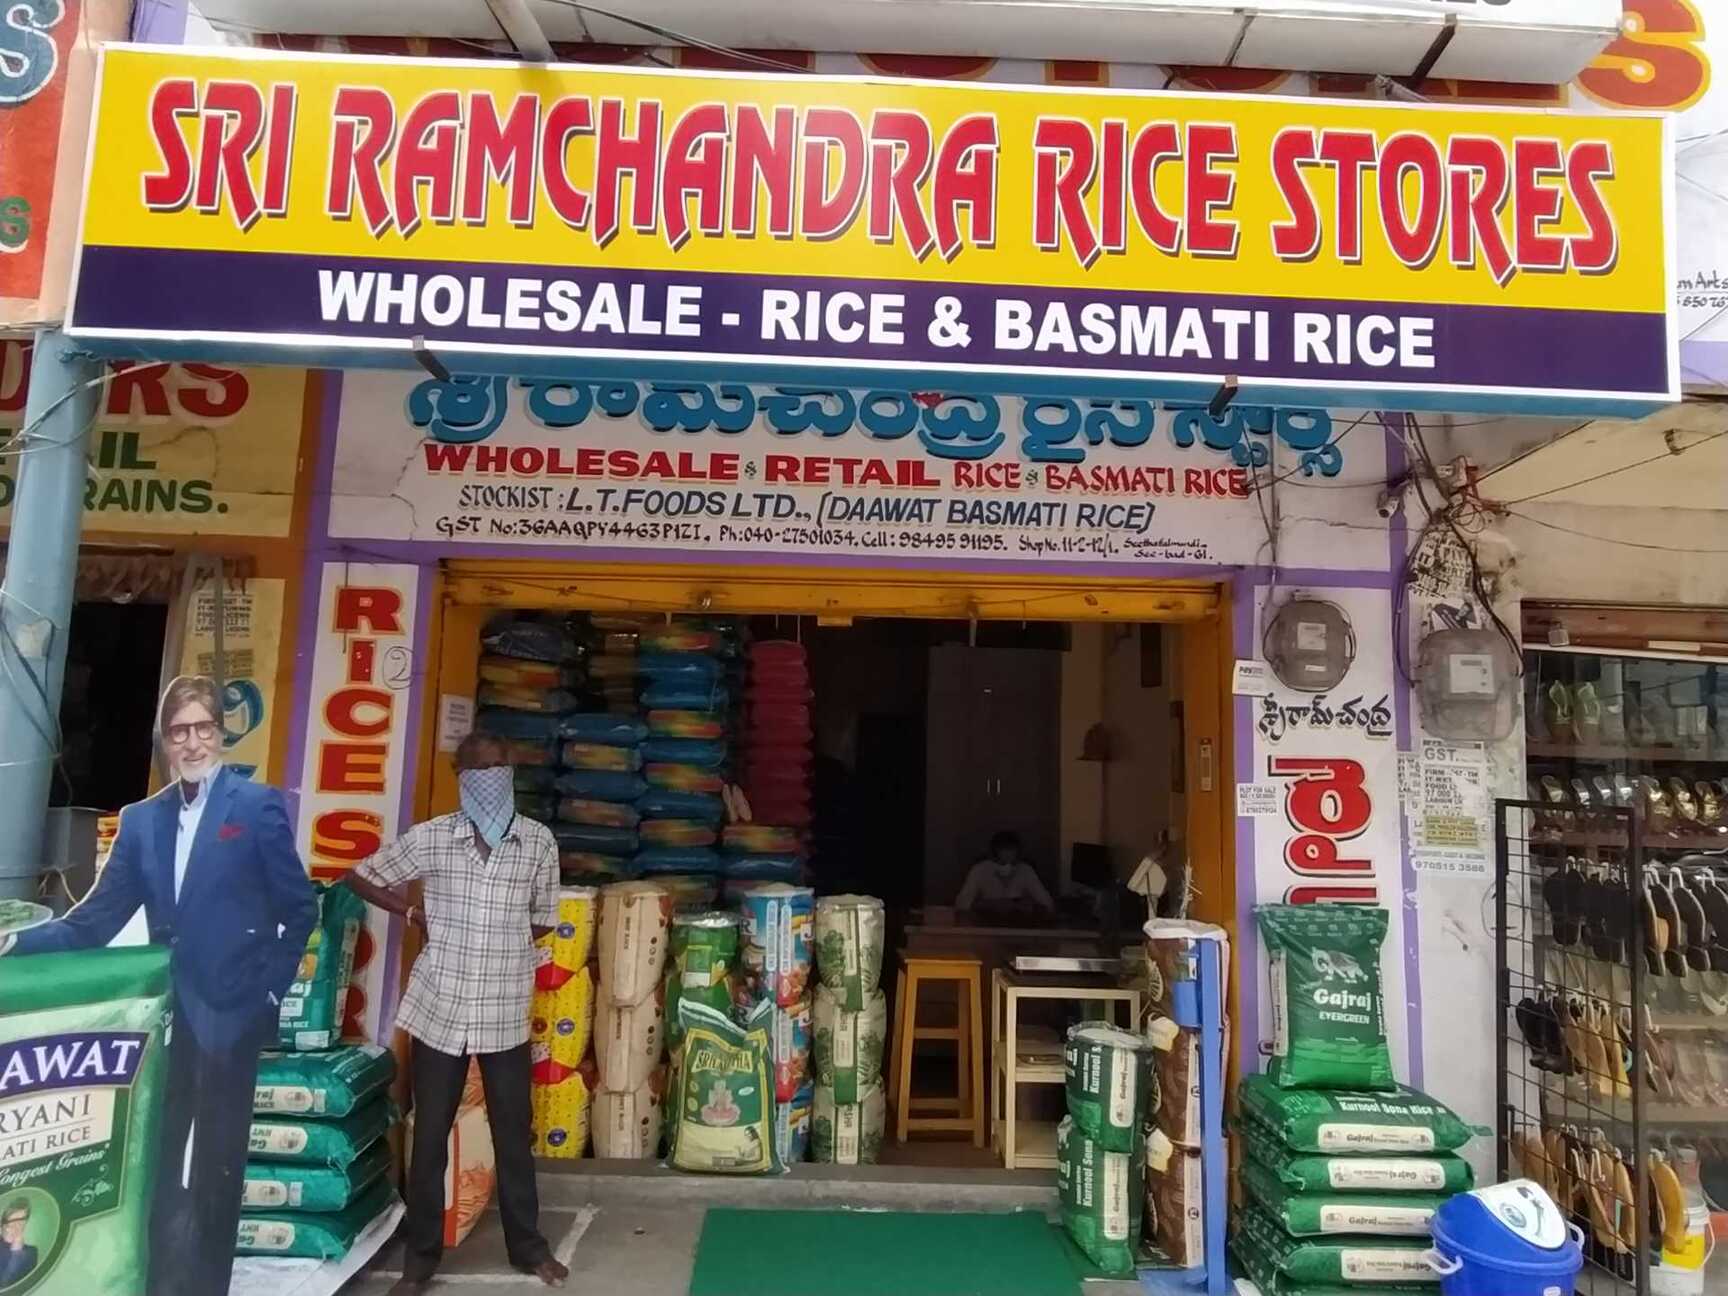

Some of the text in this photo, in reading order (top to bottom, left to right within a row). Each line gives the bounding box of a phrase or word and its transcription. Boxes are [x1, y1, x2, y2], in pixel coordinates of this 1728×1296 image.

[141, 79, 1618, 287] SRI RAMCHANDRA RICE STORES
[318, 269, 703, 337] WHOLESALE
[760, 288, 906, 345] RICE
[927, 296, 972, 348] &
[994, 298, 1270, 362] BASMATI
[1293, 312, 1436, 368] RICE
[424, 444, 740, 482] WHOLESALE
[765, 454, 941, 487] RETAIL
[953, 461, 1021, 490] RICE
[1045, 463, 1176, 495] BASMATI
[1184, 467, 1250, 497] RICE
[81, 478, 228, 514] RAINS.
[947, 499, 1067, 527] BASMATI
[436, 515, 482, 538] GST
[1313, 988, 1371, 1011] Gajraj
[0, 1040, 140, 1091] AWAT
[0, 1125, 91, 1161] ATI RICE
